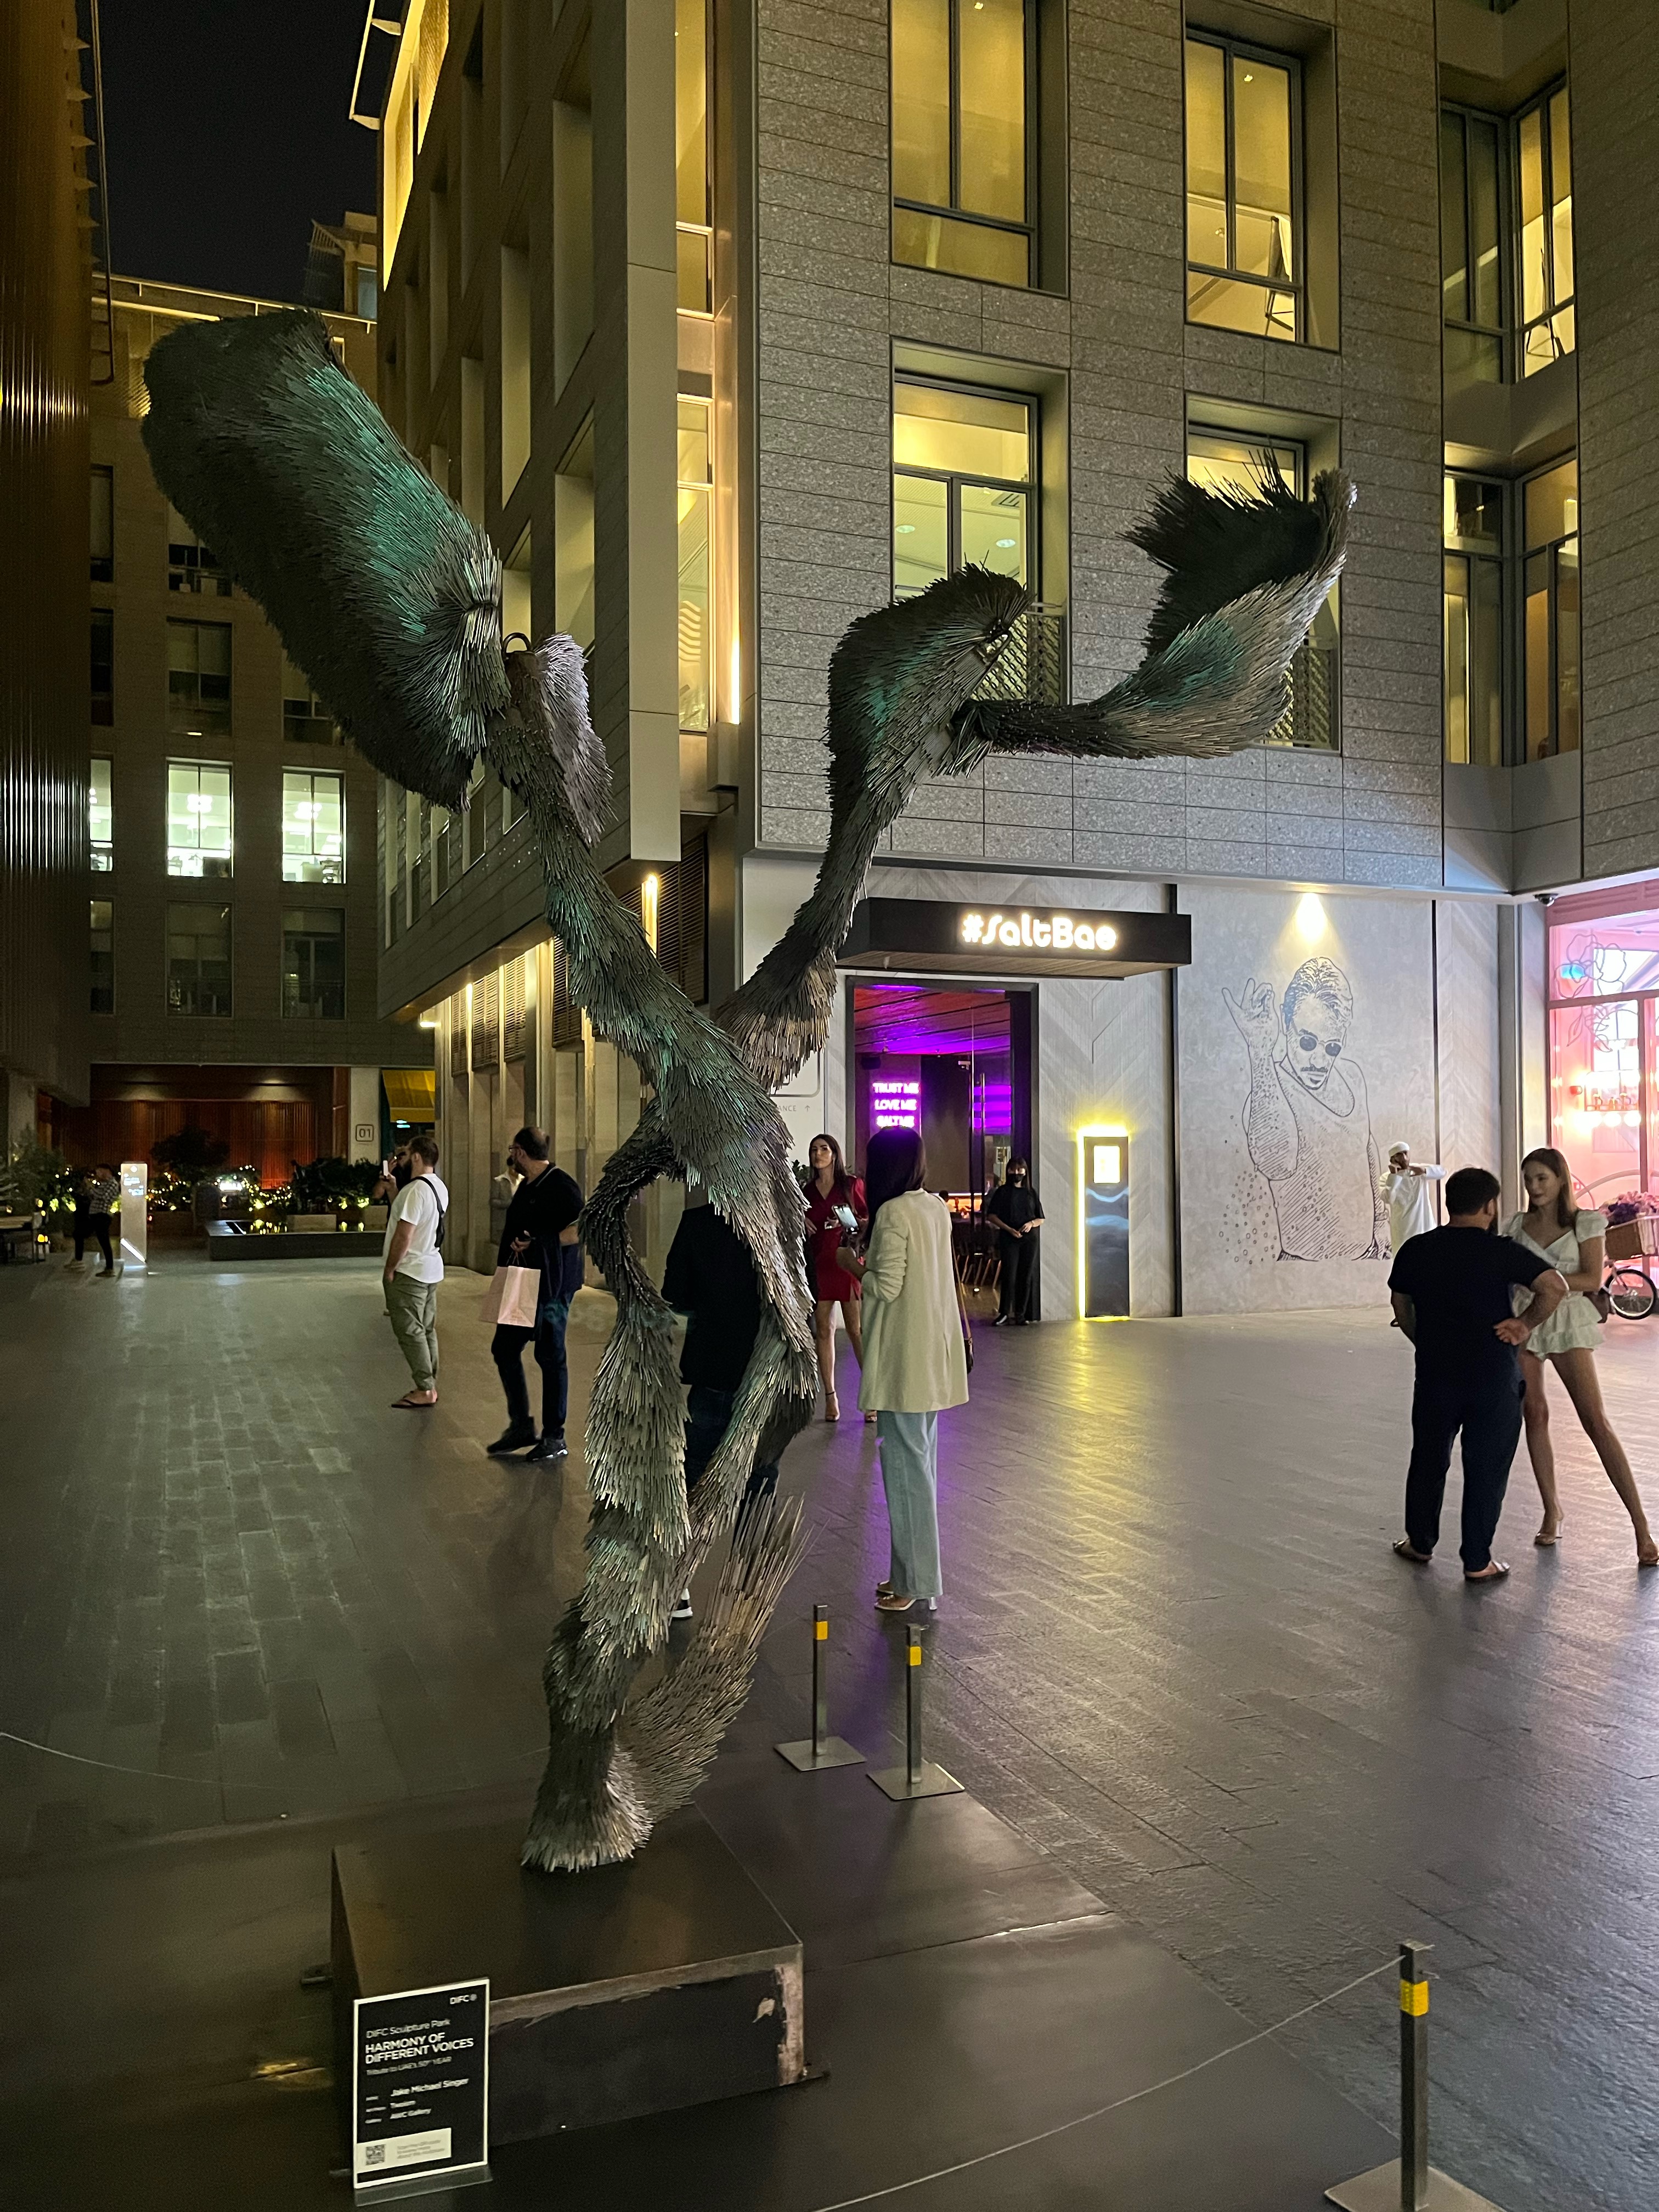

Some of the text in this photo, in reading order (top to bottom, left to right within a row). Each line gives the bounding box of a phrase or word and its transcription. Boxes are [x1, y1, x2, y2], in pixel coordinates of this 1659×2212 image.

[962, 913, 1117, 951] #SaltBae
[873, 1082, 919, 1094] TRUST ME
[874, 1099, 917, 1110] LOVE ME
[900, 1115, 915, 1128] ME
[359, 1128, 370, 1138] 01
[450, 1995, 470, 2005] DIFC
[366, 2018, 451, 2039] DIFC Sculpture Park
[365, 2032, 445, 2053] HARMONY OF
[365, 2038, 474, 2064] DIFFERENT VOICES
[411, 2081, 442, 2093] Michael
